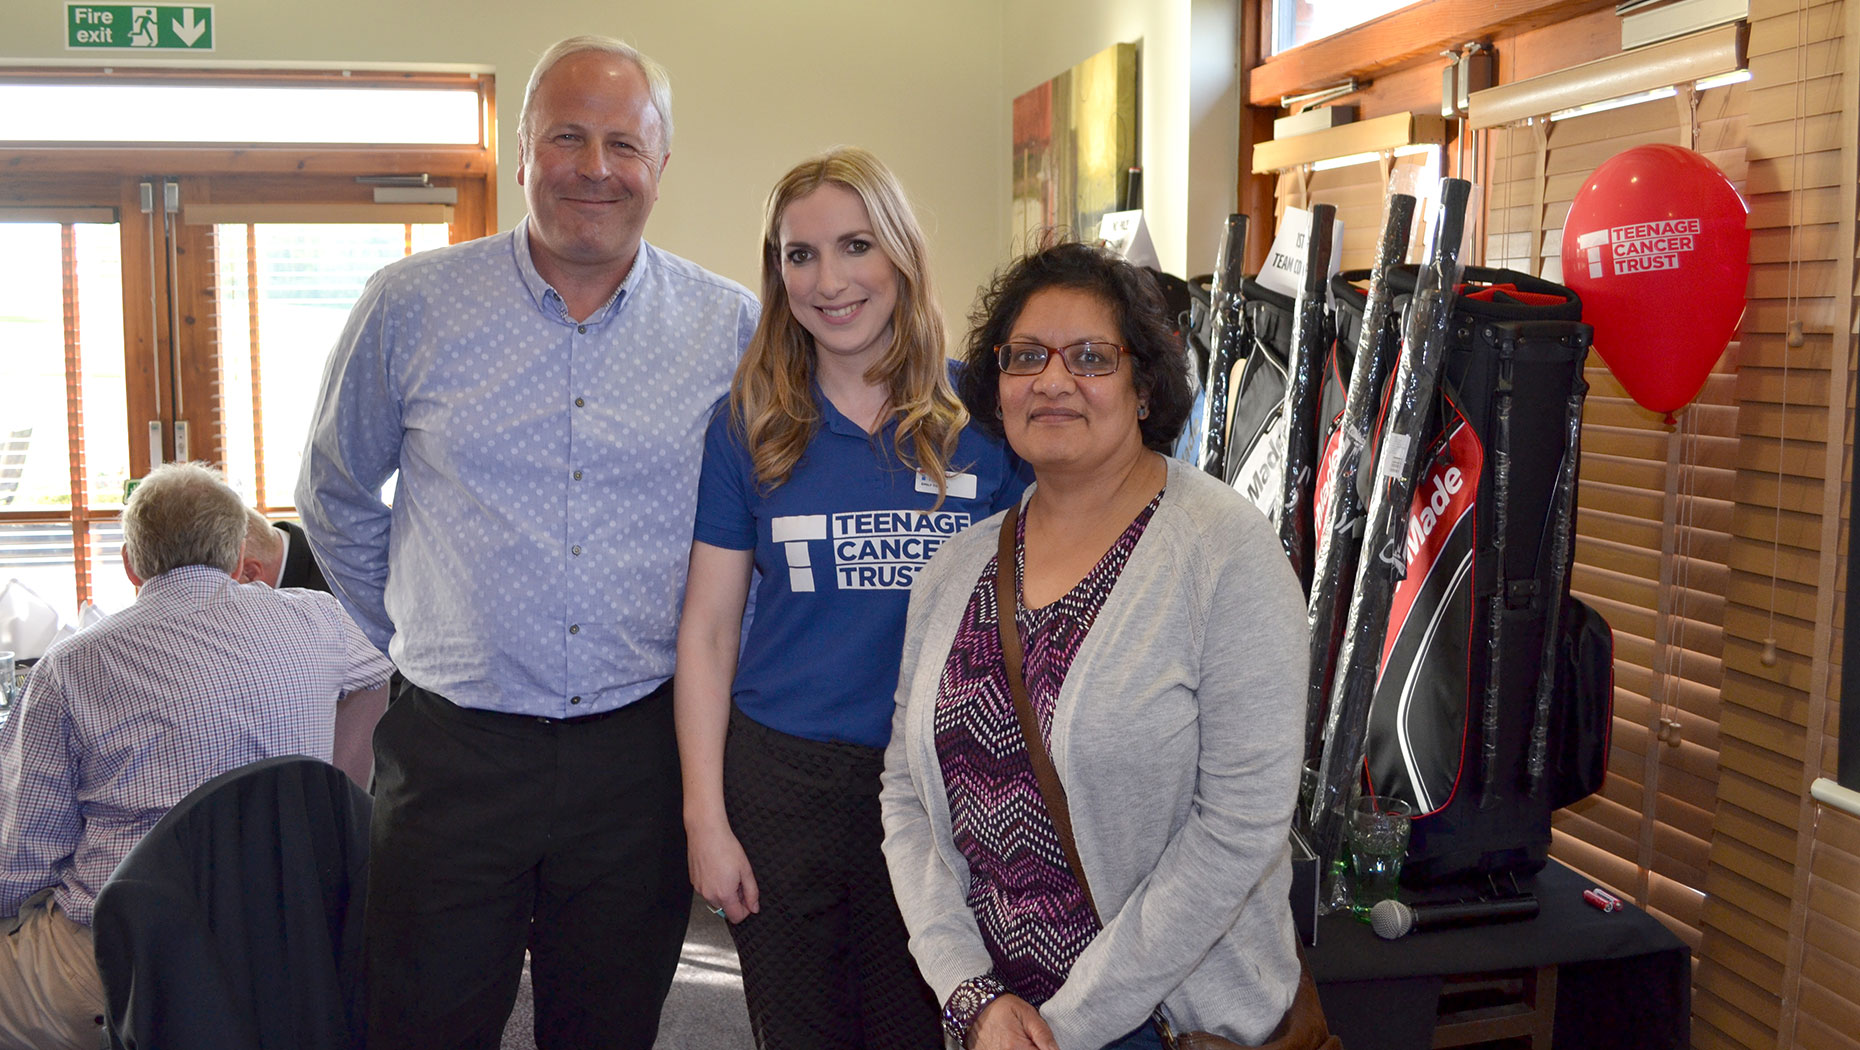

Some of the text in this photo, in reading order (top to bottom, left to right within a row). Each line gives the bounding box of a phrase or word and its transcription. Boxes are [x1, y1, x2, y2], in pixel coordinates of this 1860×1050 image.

[75, 8, 113, 24] Fire
[76, 27, 113, 43] exit
[1613, 220, 1699, 241] TEENAGE
[1613, 235, 1692, 257] CANCER
[1272, 252, 1295, 273] TEAM
[1615, 254, 1676, 273] TRUST
[835, 512, 969, 535] TEENAGE
[1406, 466, 1464, 566] Made
[837, 538, 946, 562] CANCE
[839, 565, 923, 588] TRUS
